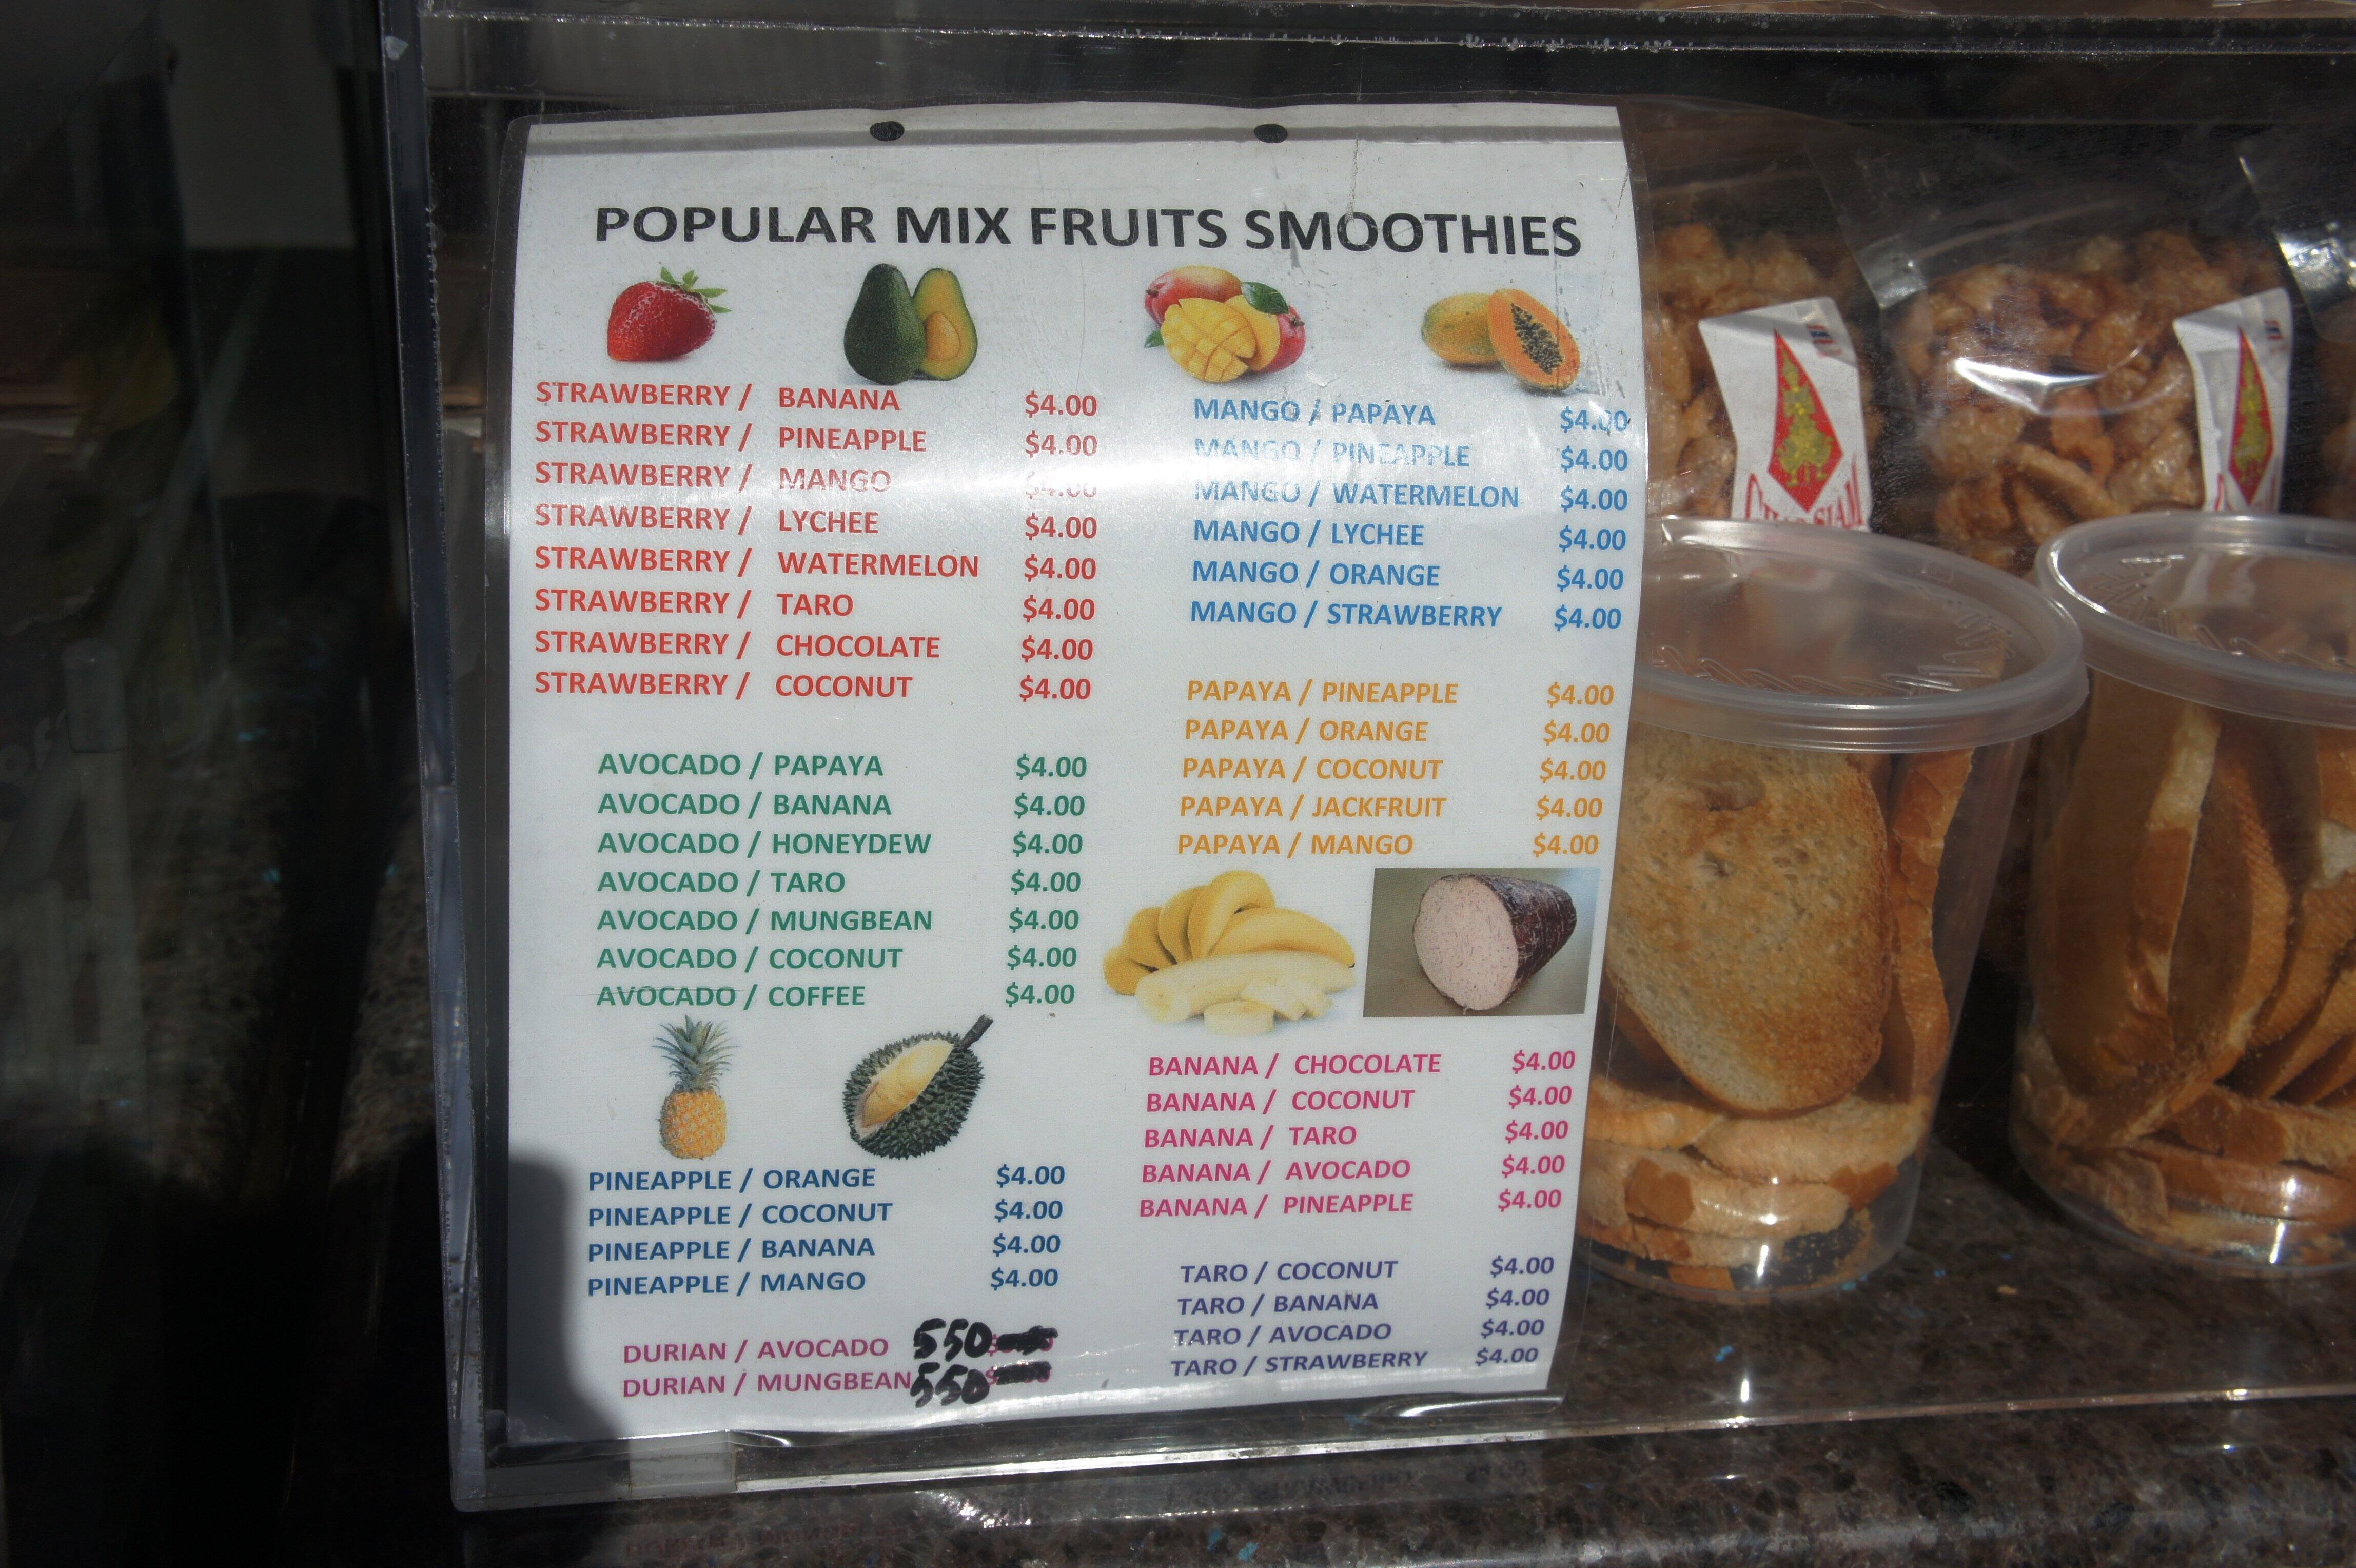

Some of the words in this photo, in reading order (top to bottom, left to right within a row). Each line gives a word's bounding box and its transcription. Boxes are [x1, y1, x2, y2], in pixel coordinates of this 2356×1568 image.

[596, 206, 877, 244] POPULAR
[896, 206, 1012, 245] MIX
[1030, 207, 1227, 249] FRUITS
[1245, 209, 1582, 258] SMOOTHIES
[536, 381, 731, 406] STRAWBERRY
[779, 387, 900, 411] BANANA
[1025, 390, 1099, 419] $4.00
[1194, 398, 1302, 423] MANGO
[1330, 400, 1438, 426] PAPAYA
[1560, 405, 1628, 434] $4.00
[535, 420, 731, 447] STRAWBERRY
[779, 426, 927, 453] PINEAPPLE
[1025, 430, 1098, 459] $4.00
[1332, 440, 1471, 468] PINEAPPLE
[1560, 445, 1629, 474] $4.00
[535, 461, 731, 488] STRAWBERRY
[779, 467, 891, 493] MANGO
[1194, 480, 1302, 504] MANGO
[1332, 481, 1520, 508] WATERMELON
[1560, 484, 1629, 513] $4.00
[535, 503, 731, 532] STRAWBERRY
[778, 509, 879, 534] LYCHEE
[1025, 512, 1097, 541] $4.00
[1193, 518, 1302, 545] MANGO
[1331, 520, 1426, 547] LYCHEE
[1558, 524, 1628, 553] $4.00
[535, 545, 731, 573] STRAWBERRY
[777, 551, 978, 578] WATERMELON
[1024, 553, 1096, 582] $4.00
[1192, 559, 1300, 584] MANGO
[1329, 561, 1442, 587] ORANGE
[1556, 564, 1625, 593] $4.00
[535, 588, 730, 614] STRAWBERRY
[776, 593, 854, 617] TARO
[1023, 594, 1095, 623] $4.00
[1190, 600, 1298, 624] MANGO
[1327, 602, 1504, 628] STRAWBERRY
[1554, 604, 1623, 632] $4.00
[535, 630, 730, 655] STRAWBERRY
[776, 634, 940, 658] CHOCOLATE
[1021, 634, 1095, 663] $4.00
[535, 671, 729, 695] STRAWBERRY
[775, 674, 913, 698] COCONUT
[1019, 674, 1091, 703] $4.00
[1186, 679, 1291, 702] PAPAYA
[1321, 681, 1460, 705] PINEAPPLE
[1546, 681, 1616, 709] $4.00
[1184, 718, 1289, 740] PAPAYA
[1319, 719, 1430, 743] ORANGE
[1543, 719, 1612, 747] $4.00
[597, 753, 742, 776] AVOCADO
[774, 754, 885, 777] PAPAYA
[1015, 752, 1088, 781] $4.00
[1182, 756, 1286, 779] PAPAYA
[1315, 757, 1445, 781] COCONUT
[1539, 757, 1607, 785] $4.00
[597, 792, 741, 815] AVOCADO
[773, 793, 893, 816] BANANA
[1014, 792, 1086, 820] $4.00
[1179, 795, 1284, 816] PAPAYA
[1311, 795, 1449, 819] JACKFRUIT
[1536, 794, 1604, 821] $4.00
[597, 831, 741, 855] AVOCADO
[772, 832, 932, 855] HONEYDEW
[1012, 830, 1084, 858] $4.00
[1177, 833, 1282, 855] PAPAYA
[1310, 833, 1415, 856] MANGO
[1532, 832, 1600, 858] $4.00
[597, 871, 740, 893] AVOCADO
[770, 871, 847, 894] TARO
[1010, 868, 1082, 896] $4.00
[596, 909, 739, 932] AVOCADO
[771, 909, 933, 932] MUNGBEAN
[1008, 906, 1081, 934] $4.00
[596, 947, 738, 969] AVOCADO
[769, 947, 904, 970] COCONUT
[1007, 944, 1078, 971] $4.00
[596, 985, 739, 1007] AVOCADO
[768, 985, 866, 1008] COFFEE
[1005, 981, 1076, 1008] $4.00
[1149, 1055, 1259, 1076] BANANA
[1294, 1053, 1442, 1075] CHOCOLATE
[1511, 1049, 1576, 1075] $4.00
[1147, 1092, 1256, 1112] BANANA
[1291, 1089, 1416, 1111] COCONUT
[1508, 1084, 1573, 1110] $4.00
[1144, 1127, 1253, 1148] BANANA
[1288, 1125, 1357, 1146] TARO
[1505, 1119, 1569, 1145] $4.00
[589, 1170, 732, 1191] PINEAPPLE
[763, 1168, 876, 1189] ORANGE
[996, 1163, 1067, 1189] $4.00
[1142, 1163, 1251, 1183] BANANA
[1285, 1159, 1411, 1181] AVOCADO
[1501, 1153, 1566, 1179] $4.00
[588, 1206, 731, 1227] PINEAPPLE
[762, 1202, 894, 1225] COCONUT
[994, 1198, 1064, 1223] $4.00
[1140, 1197, 1248, 1218] BANANA
[1283, 1193, 1414, 1214] PINEAPPLE
[1498, 1188, 1562, 1212] $4.00
[588, 1240, 731, 1262] PINEAPPLE
[761, 1237, 876, 1259] BANANA
[992, 1232, 1061, 1258] $4.00
[588, 1275, 729, 1297] PINEAPPLE
[760, 1271, 867, 1292] MANGO
[990, 1266, 1059, 1291] $4.00
[1180, 1263, 1248, 1283] TARO
[1277, 1260, 1399, 1281] COCONUT
[1489, 1255, 1555, 1279] $4.00
[1177, 1296, 1245, 1316] TARO
[1273, 1290, 1379, 1313] BANANA
[1485, 1287, 1550, 1310] $4.00
[1173, 1327, 1242, 1347] TARO
[1268, 1323, 1392, 1344] AVOCADO
[1480, 1318, 1545, 1340] $4.00
[623, 1342, 728, 1364] DURIAN
[757, 1338, 889, 1359] AVOCADO
[1170, 1358, 1238, 1377] TARO
[1264, 1350, 1429, 1373] STRAWBERRY
[1475, 1346, 1539, 1367] $4.00
[623, 1375, 725, 1398] DURIAN
[757, 1370, 911, 1394] MUNGBEAN
